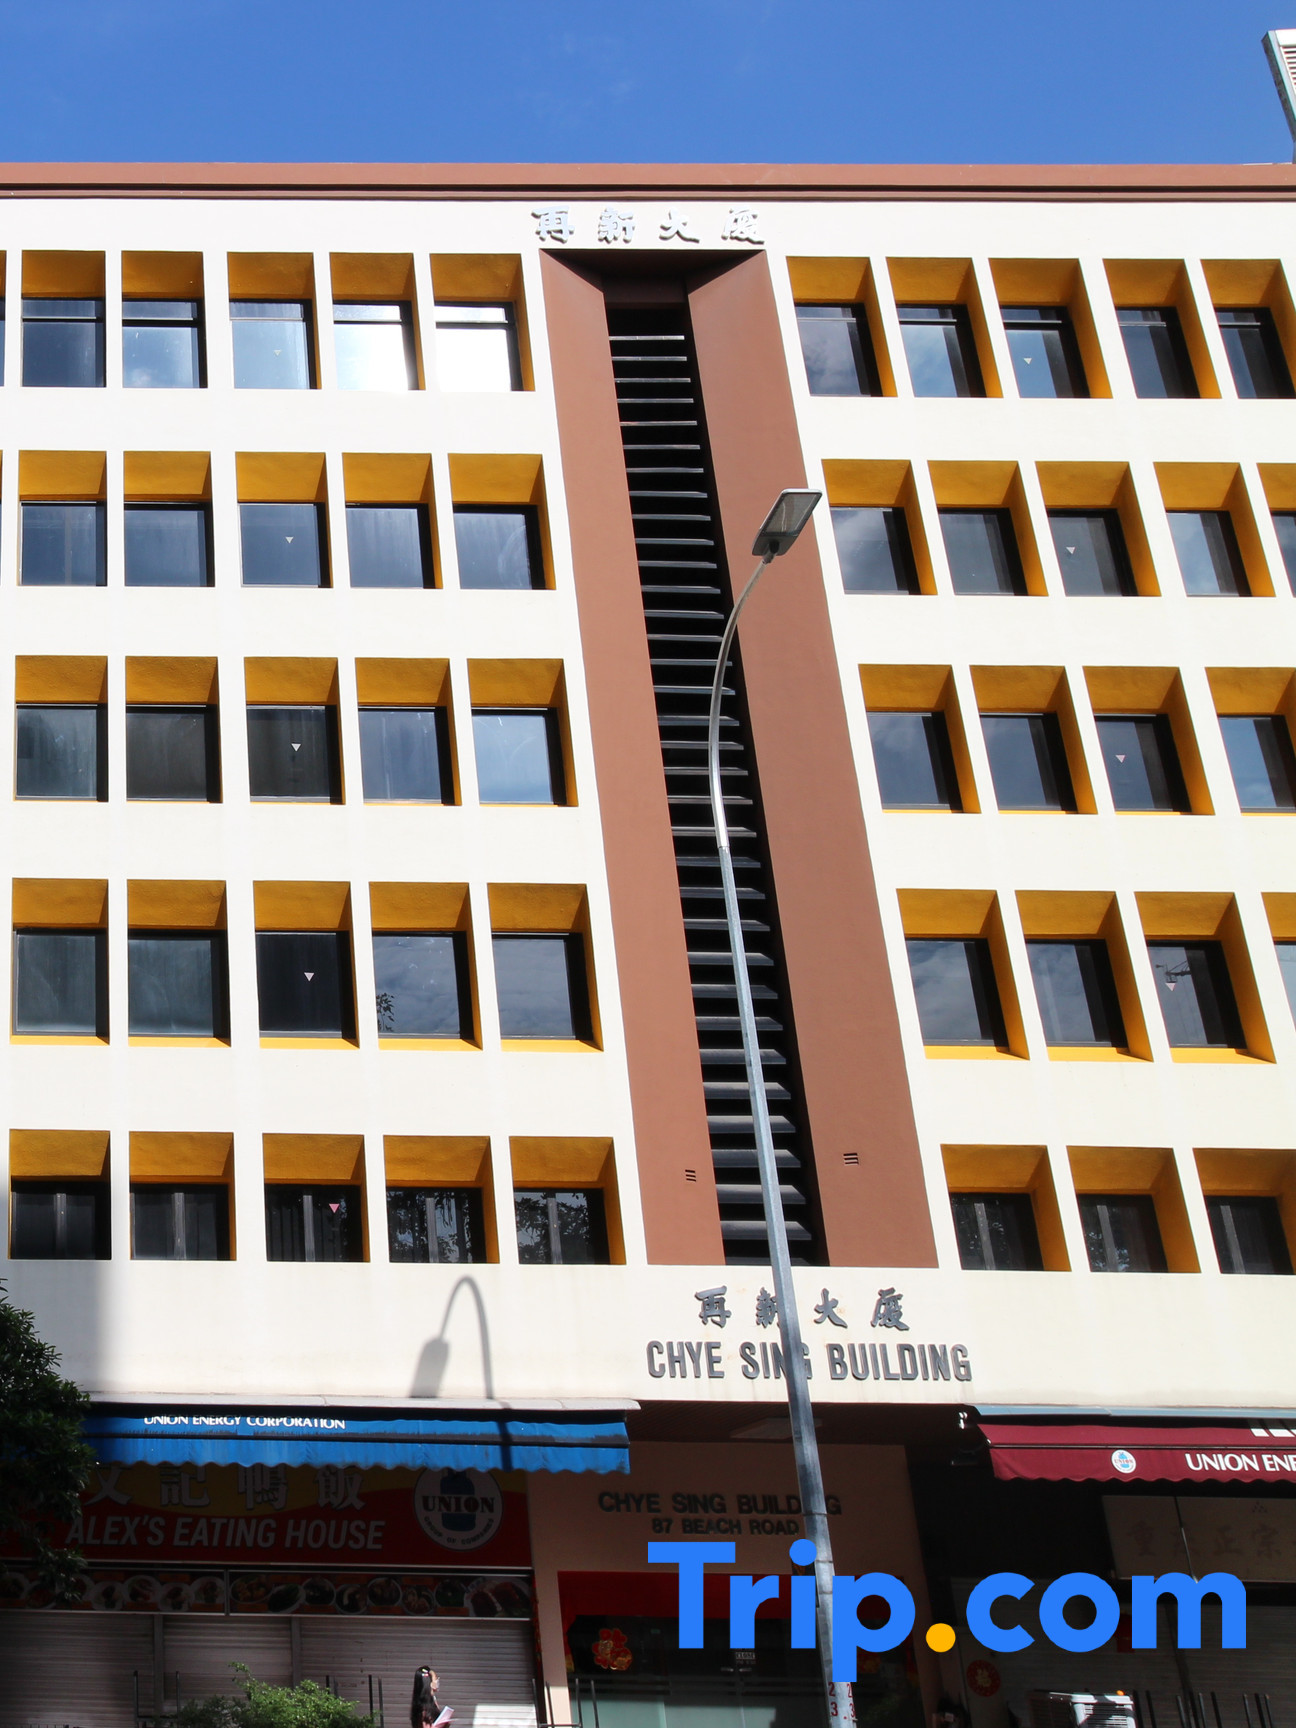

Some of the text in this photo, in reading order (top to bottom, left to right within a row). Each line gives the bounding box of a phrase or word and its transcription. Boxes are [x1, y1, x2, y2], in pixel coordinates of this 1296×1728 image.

[646, 1340, 725, 1379] CHYE
[826, 1342, 972, 1381] BUILDING
[144, 1416, 346, 1429] UNION ENERGY CORPORATION
[1185, 1453, 1260, 1472] UNION
[422, 1495, 495, 1513] UNION
[598, 1492, 842, 1515] CHYE SING BUILDG
[64, 1515, 387, 1550] ALEX'S EATING HOUSE
[652, 1518, 800, 1535] 87 BEACH ROAD
